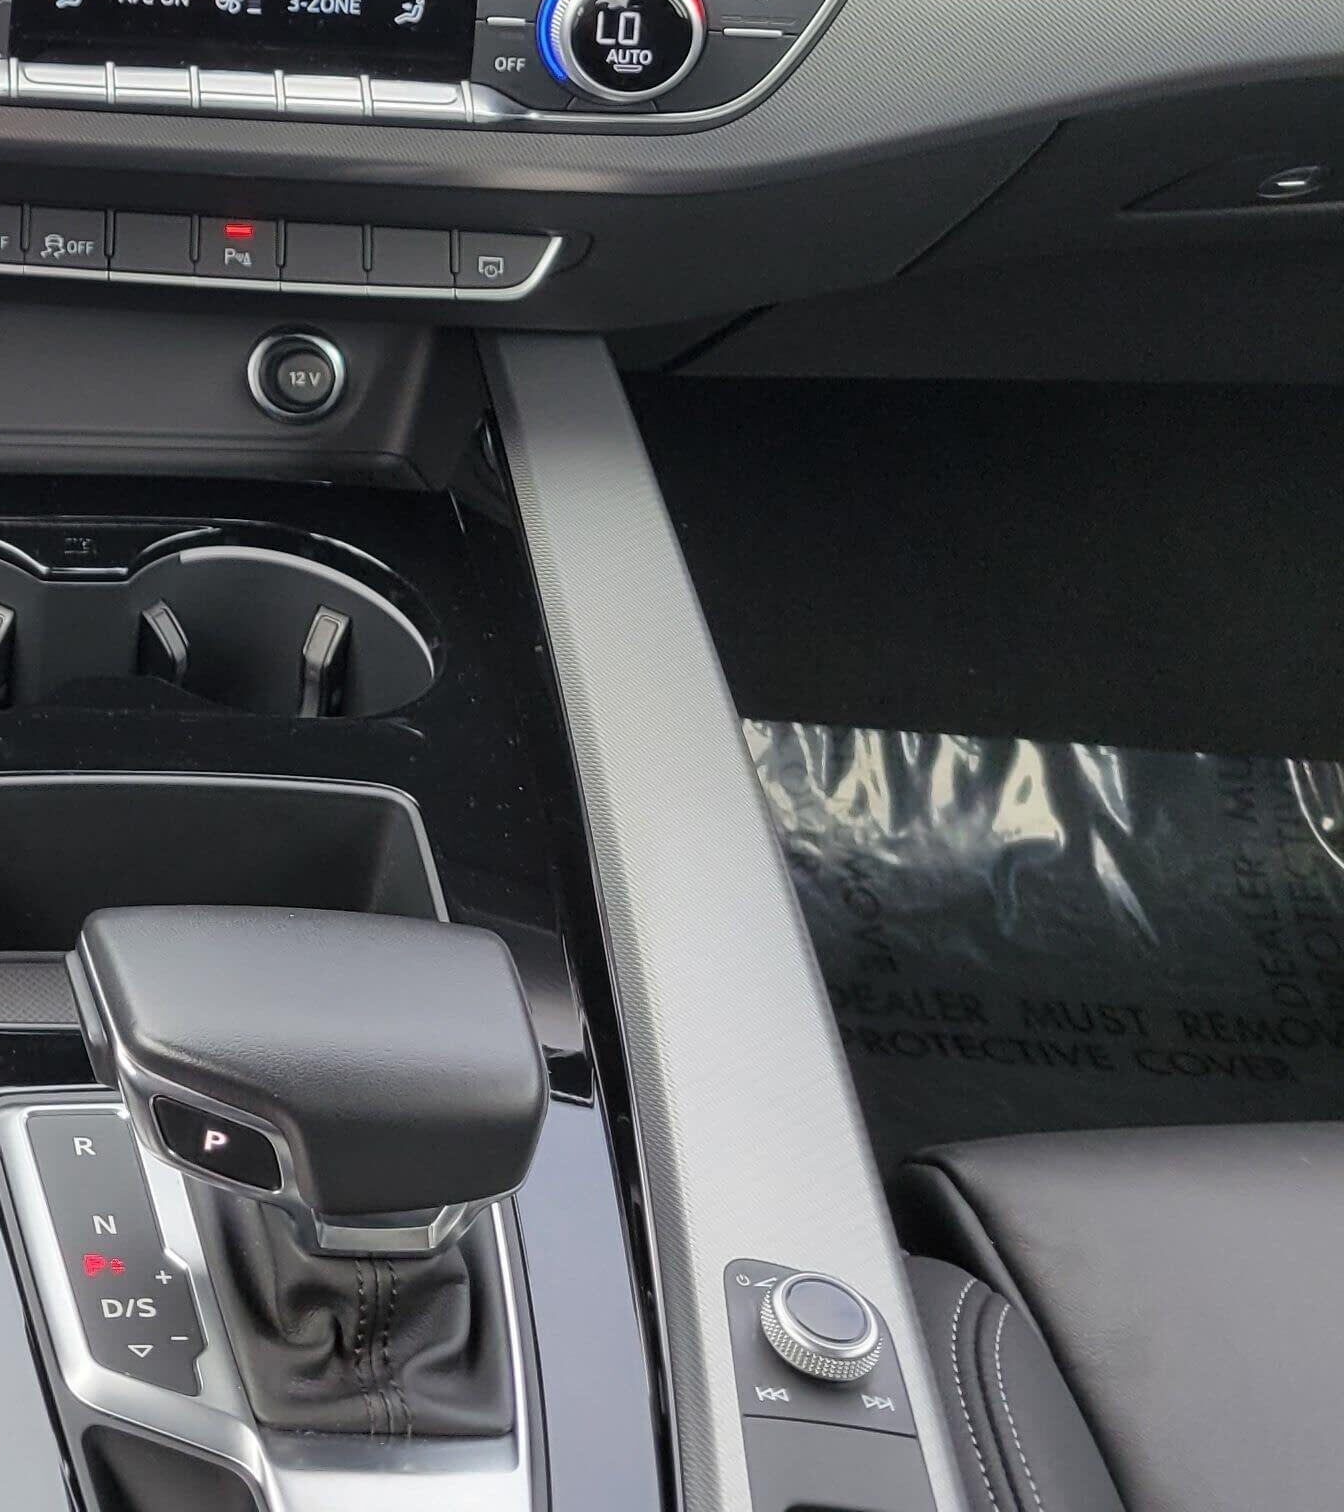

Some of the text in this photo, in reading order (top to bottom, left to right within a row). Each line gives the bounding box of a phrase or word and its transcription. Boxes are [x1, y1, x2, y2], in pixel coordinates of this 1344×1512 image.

[595, 10, 641, 46] LO
[494, 57, 526, 73] OFF
[605, 48, 653, 65] AUTO
[66, 240, 95, 255] OFF
[289, 370, 321, 387] 12 V
[73, 1137, 97, 1156] R
[203, 1129, 226, 1152] P
[92, 1215, 118, 1236] N
[101, 1297, 158, 1319] D/S
